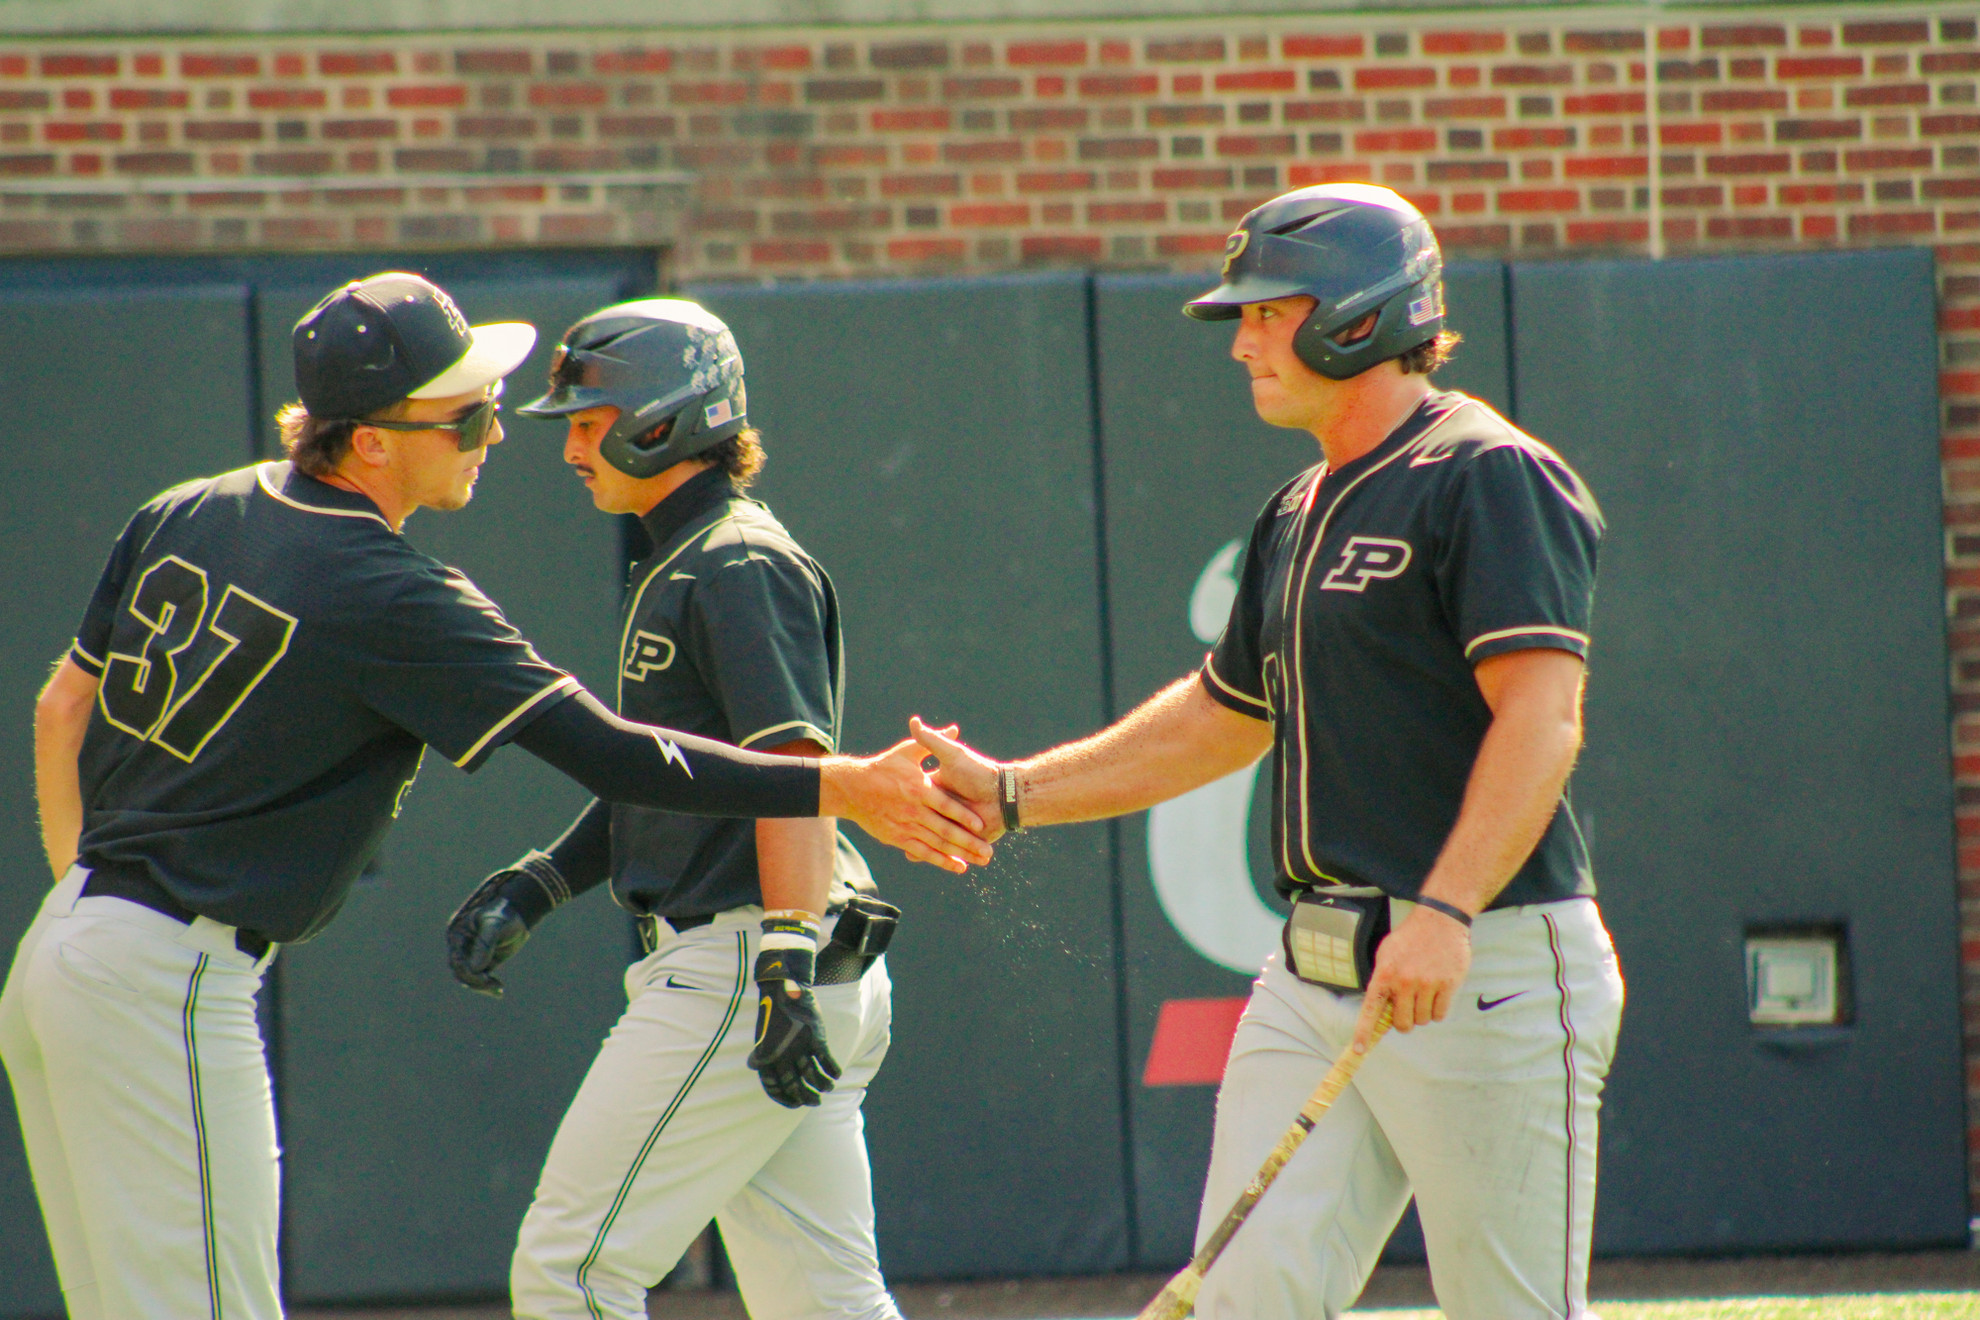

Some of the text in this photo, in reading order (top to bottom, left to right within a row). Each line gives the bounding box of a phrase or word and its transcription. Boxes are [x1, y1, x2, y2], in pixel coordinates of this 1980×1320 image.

[1320, 536, 1413, 592] P
[98, 554, 298, 763] 37
[623, 629, 676, 682] P
